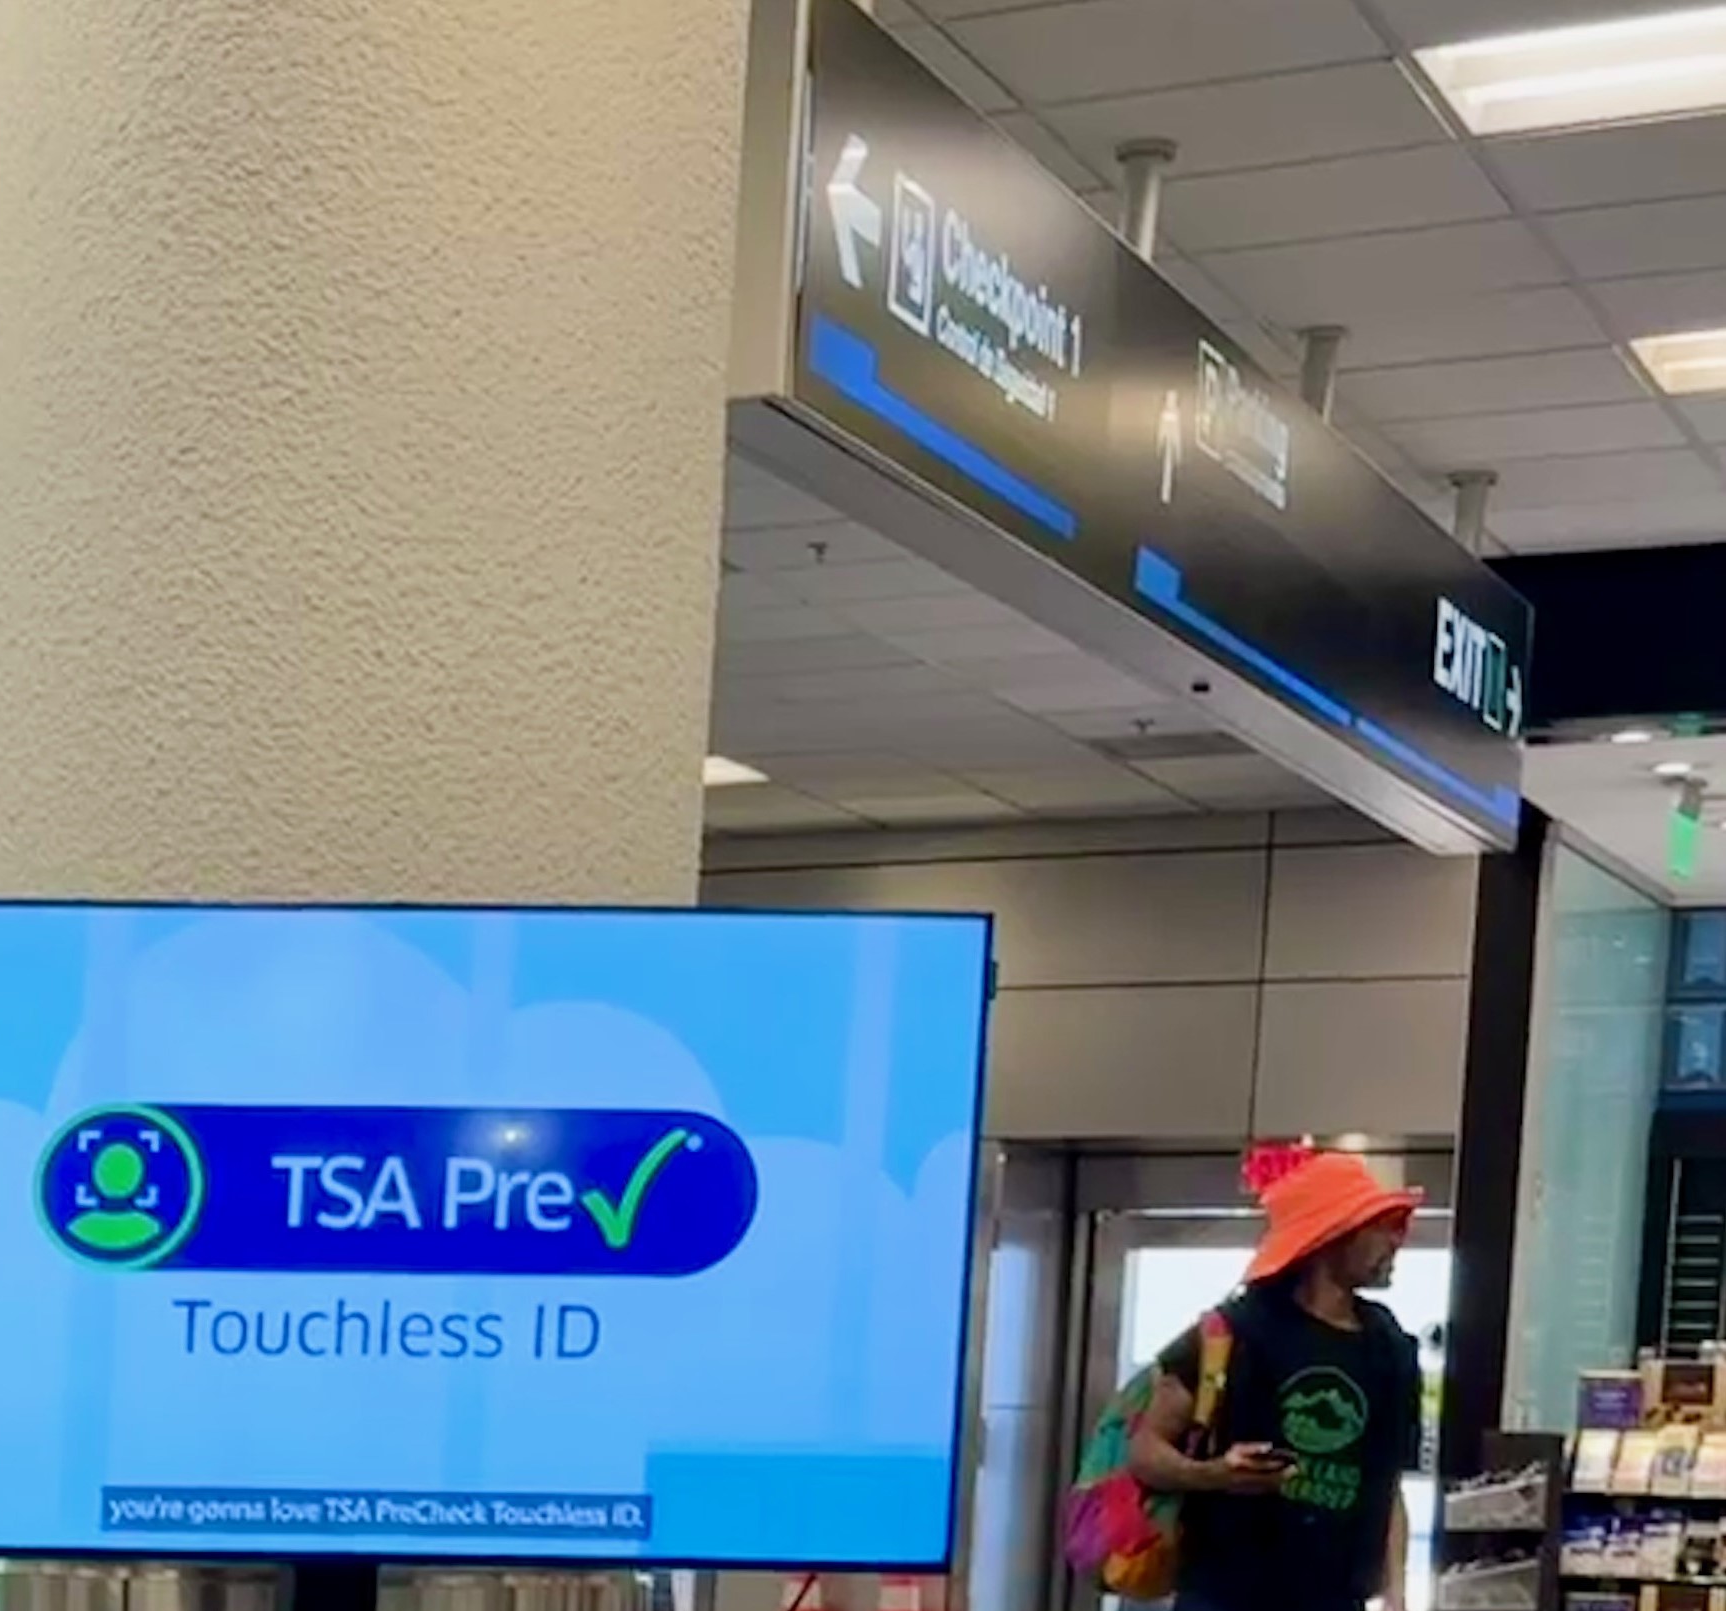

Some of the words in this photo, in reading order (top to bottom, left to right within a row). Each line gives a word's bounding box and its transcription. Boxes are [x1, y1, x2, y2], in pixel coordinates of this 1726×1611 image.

[943, 207, 1066, 368] Checkpoint
[1071, 315, 1081, 378] 1
[1433, 596, 1488, 711] EXIT
[271, 1155, 422, 1231] TSA
[443, 1156, 574, 1233] Pre
[172, 1299, 503, 1358] Touchless
[533, 1302, 602, 1360] ID
[109, 1496, 185, 1523] you're
[188, 1500, 265, 1524] gonna
[270, 1498, 321, 1522] love
[323, 1499, 373, 1523] TSA
[375, 1500, 488, 1524] PreCheck
[492, 1502, 607, 1526] Touchless
